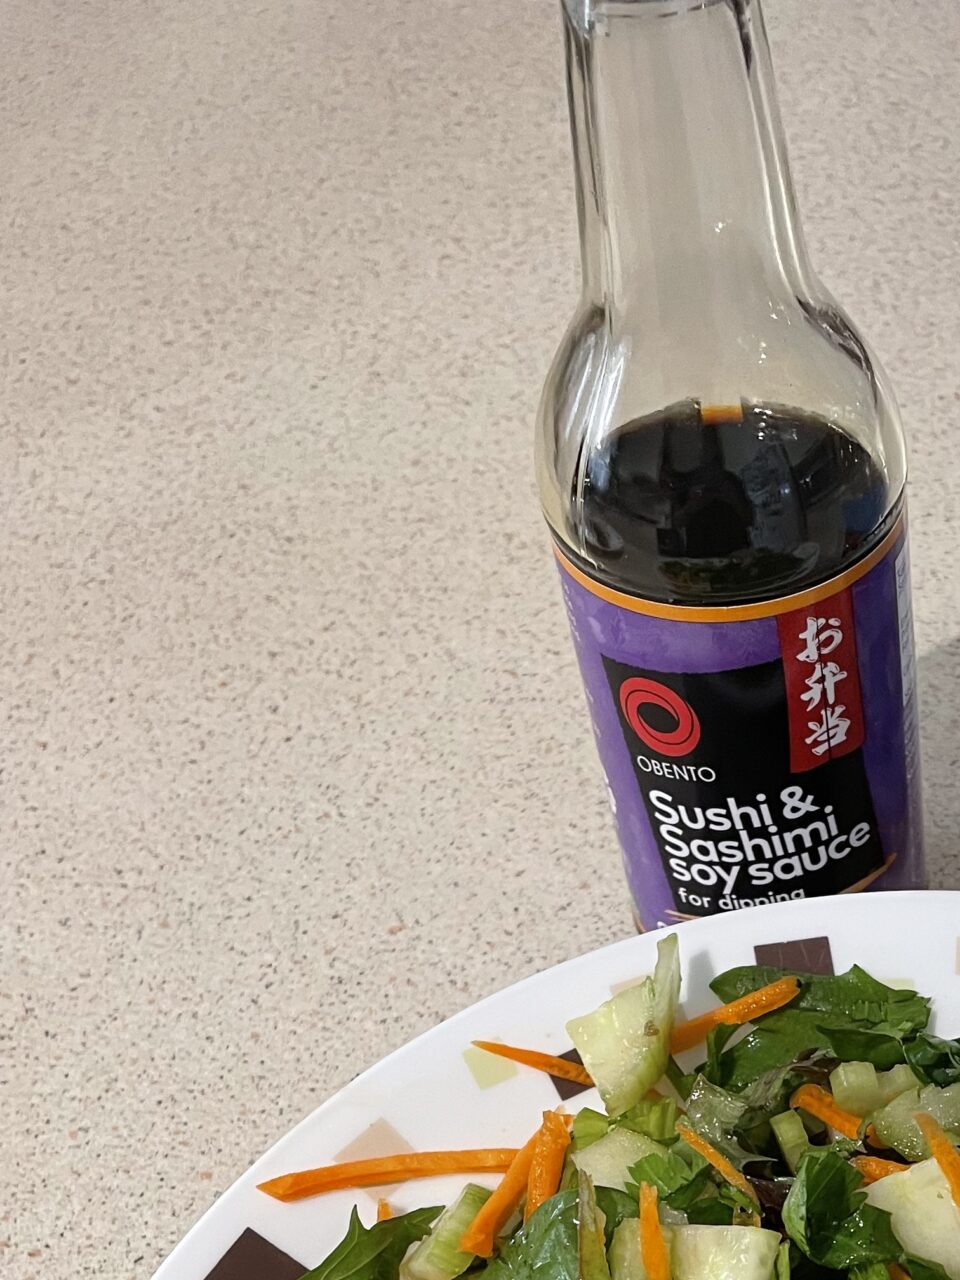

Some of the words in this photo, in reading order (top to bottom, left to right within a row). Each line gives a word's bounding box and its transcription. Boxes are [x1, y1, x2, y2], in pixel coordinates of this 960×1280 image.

[796, 616, 851, 757] お弁当
[637, 755, 716, 783] OBENTO
[648, 789, 774, 832] Sushi
[779, 785, 821, 820] &
[658, 804, 839, 865] Sashimi
[667, 857, 742, 895] soy
[750, 820, 871, 886] sauce
[677, 887, 711, 909] for
